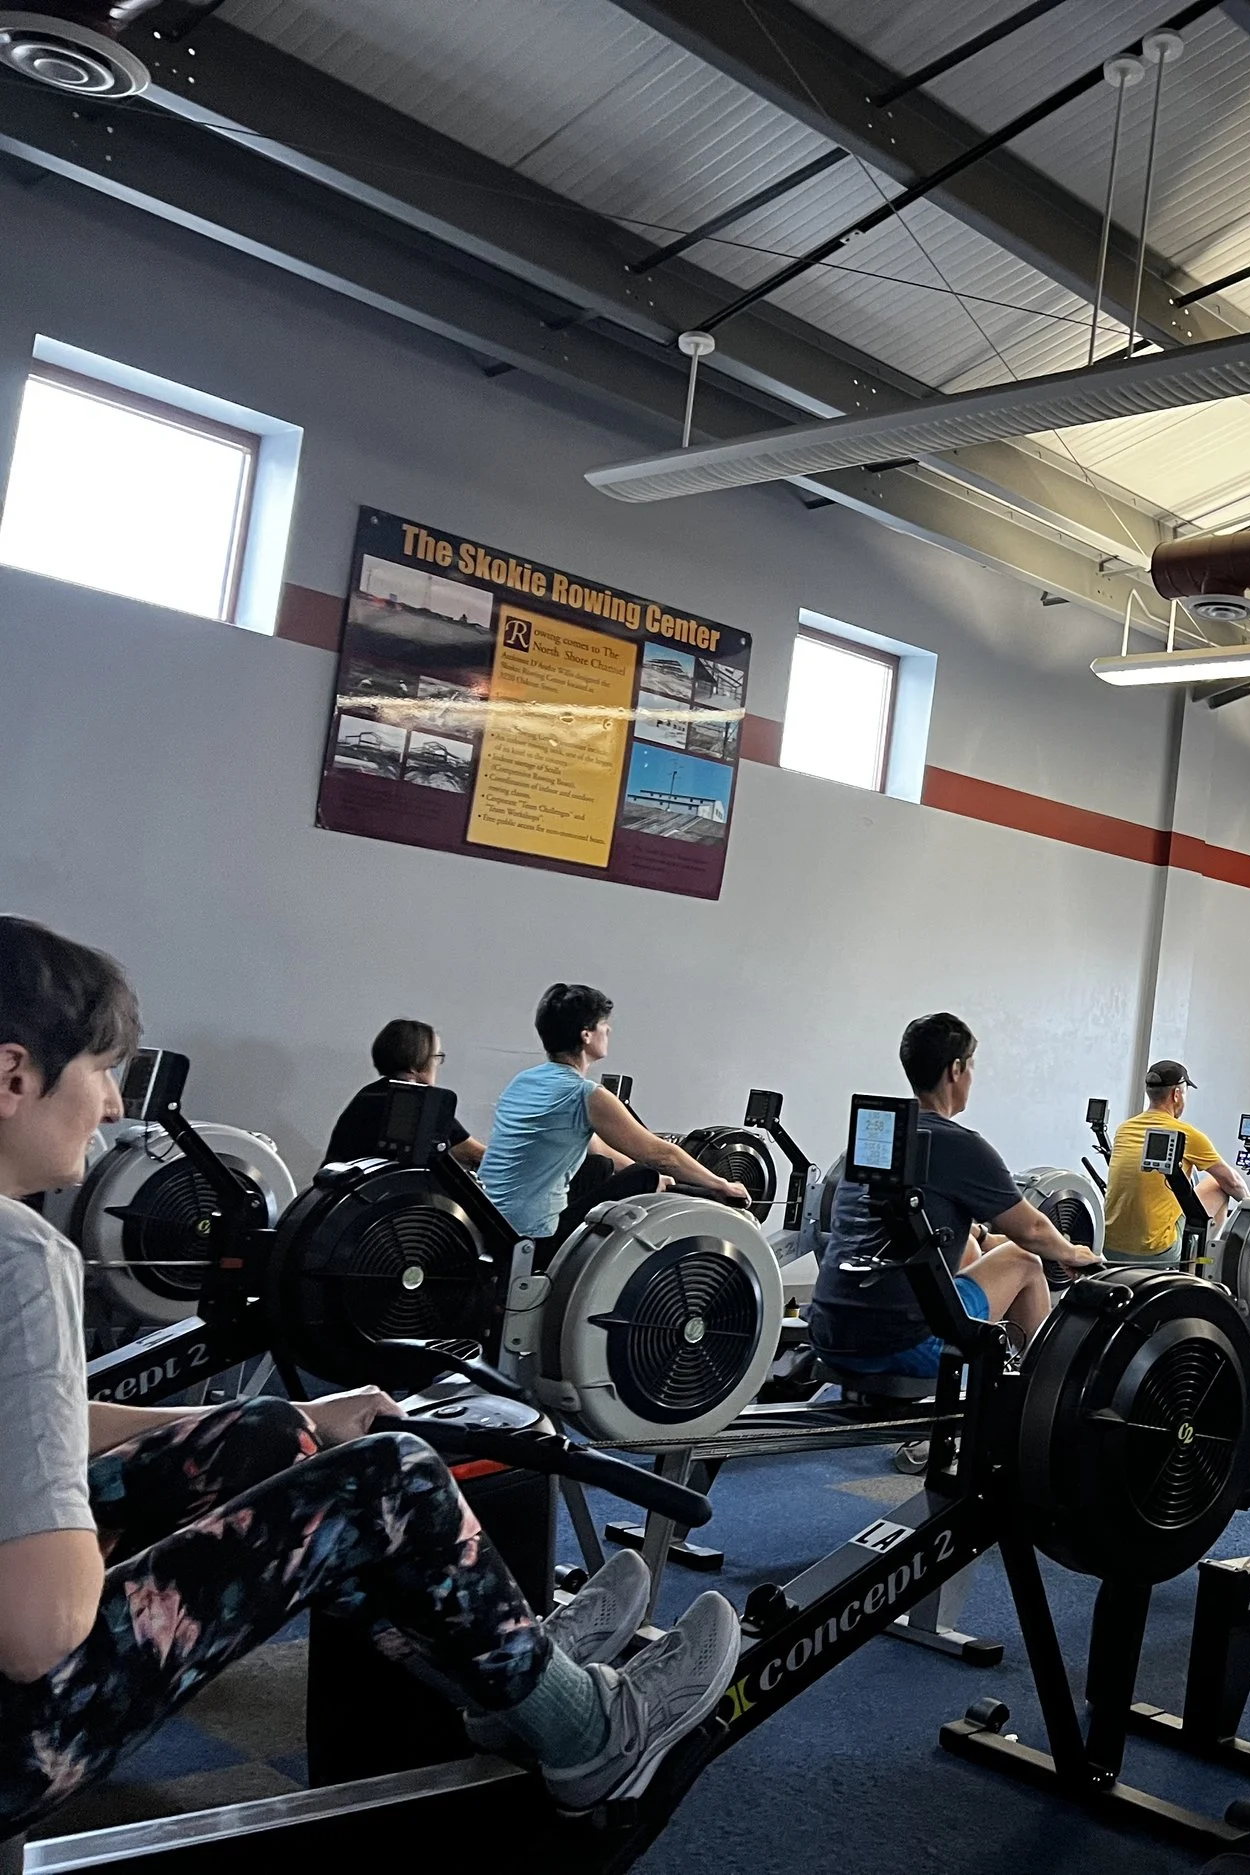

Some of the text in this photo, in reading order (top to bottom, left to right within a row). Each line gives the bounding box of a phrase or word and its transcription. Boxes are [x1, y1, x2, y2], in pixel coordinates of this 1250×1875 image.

[402, 523, 721, 652] The Skokie Rowing Center
[532, 641, 560, 657] North
[564, 651, 588, 666] Shore
[563, 637, 590, 651] comes
[591, 645, 600, 654] to
[602, 646, 620, 660] The
[92, 1343, 210, 1401] cept 2
[855, 1522, 907, 1551] LA
[759, 1529, 955, 1691] concept 2
